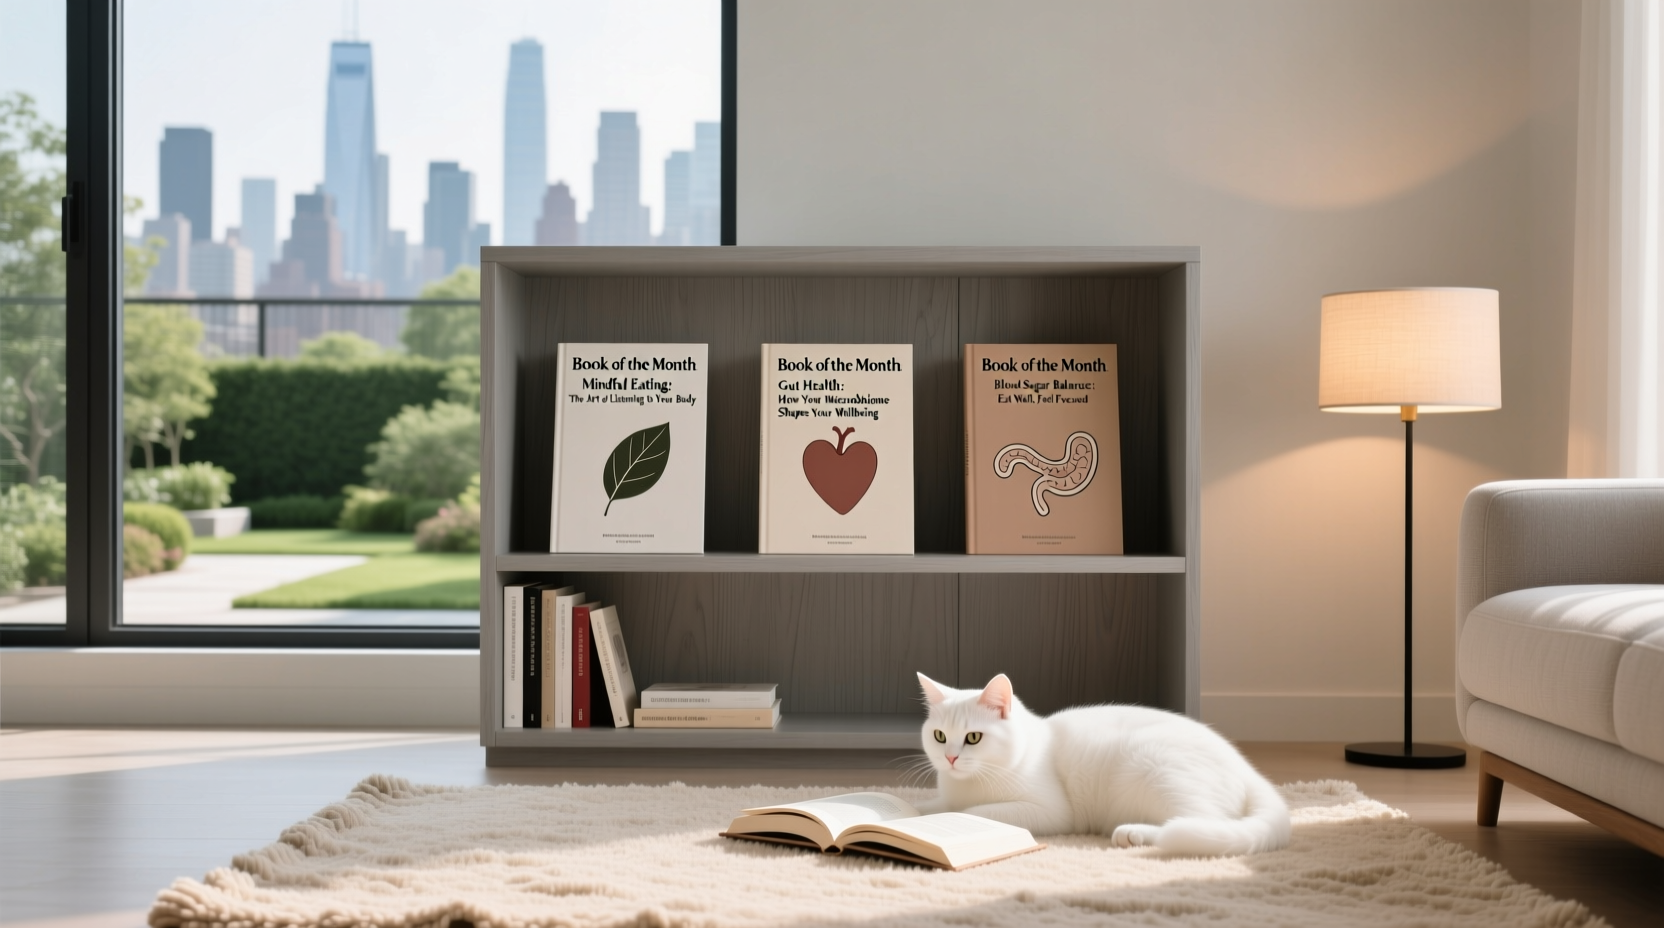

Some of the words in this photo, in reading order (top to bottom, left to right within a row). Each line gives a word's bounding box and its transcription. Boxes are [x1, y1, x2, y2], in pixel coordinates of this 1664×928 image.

[572, 357, 609, 370] Book
[612, 357, 627, 370] of
[628, 357, 650, 370] the
[653, 357, 697, 371] Month
[778, 357, 813, 371] Book
[816, 357, 830, 371] of
[831, 357, 853, 371] the
[856, 357, 902, 371] Month
[982, 357, 1018, 372] Book
[1021, 358, 1036, 371] of
[1036, 358, 1058, 372] the
[1061, 358, 1107, 372] Month
